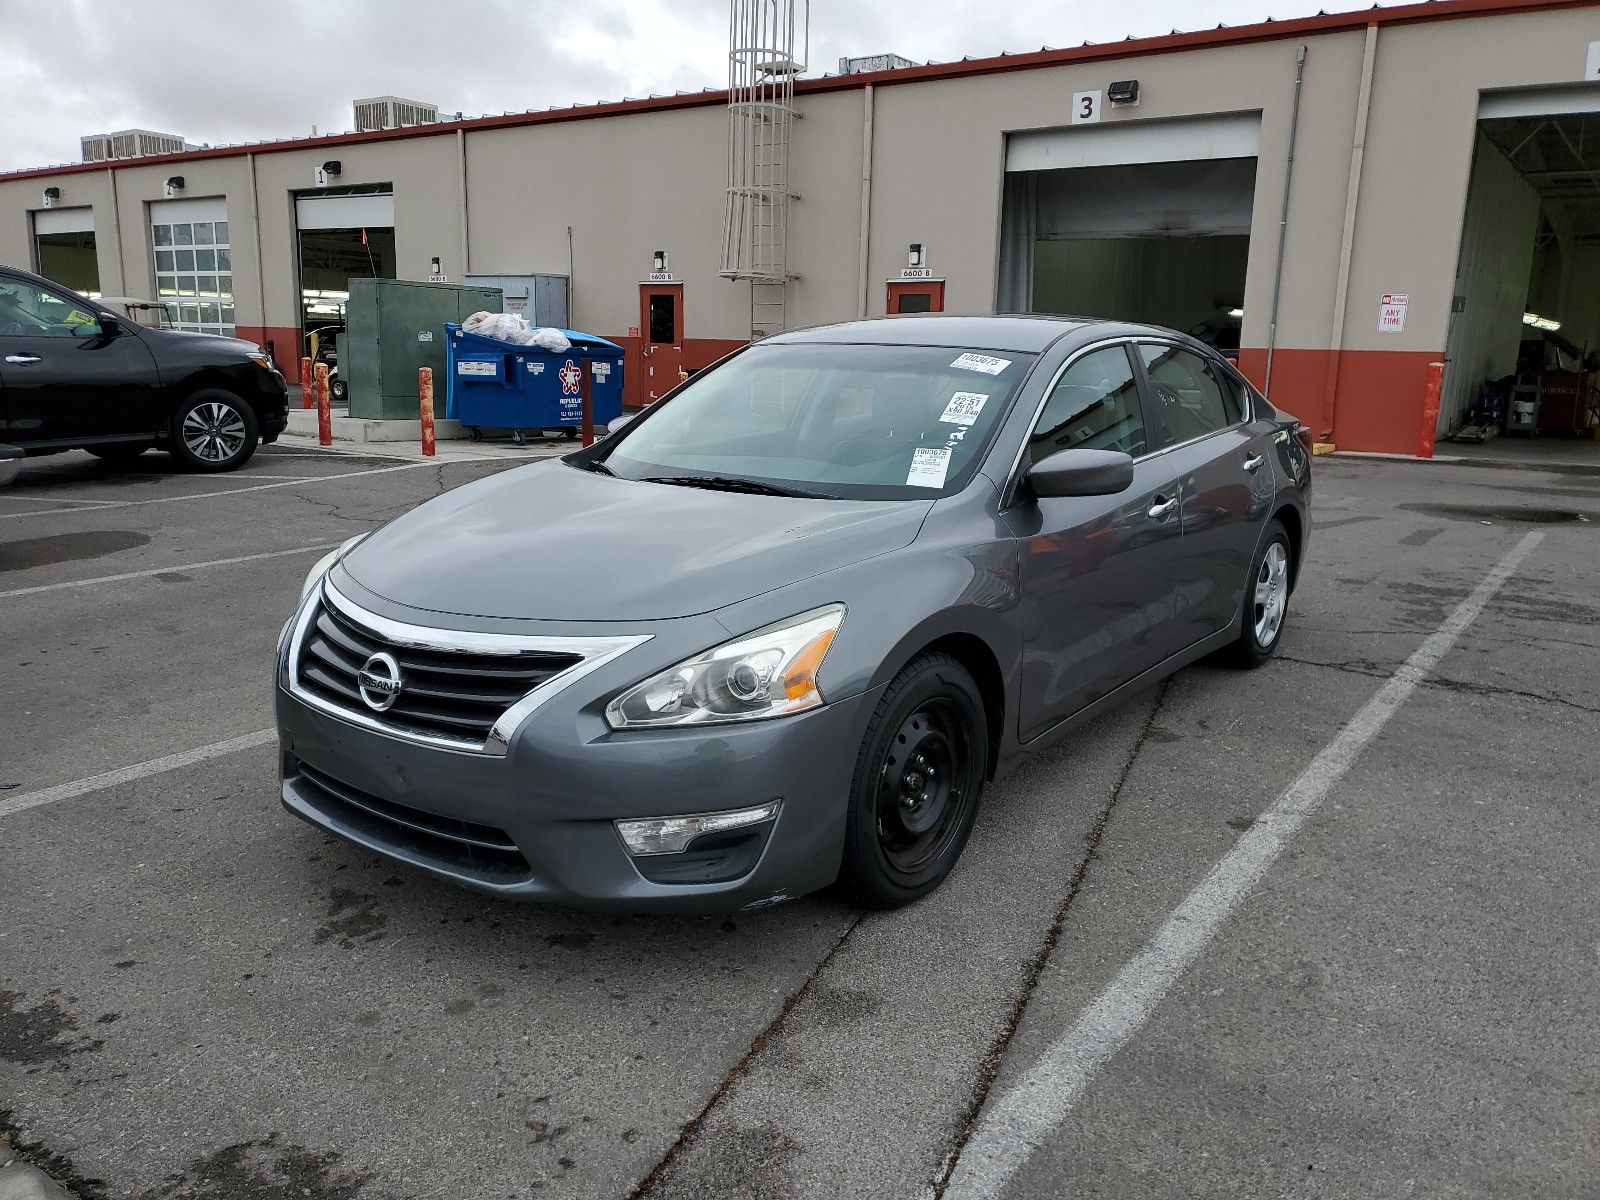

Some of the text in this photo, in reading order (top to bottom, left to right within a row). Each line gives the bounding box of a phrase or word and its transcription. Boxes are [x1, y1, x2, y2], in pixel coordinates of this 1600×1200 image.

[1079, 96, 1093, 119] 3
[318, 169, 324, 184] 1
[962, 354, 1001, 366] 1003675
